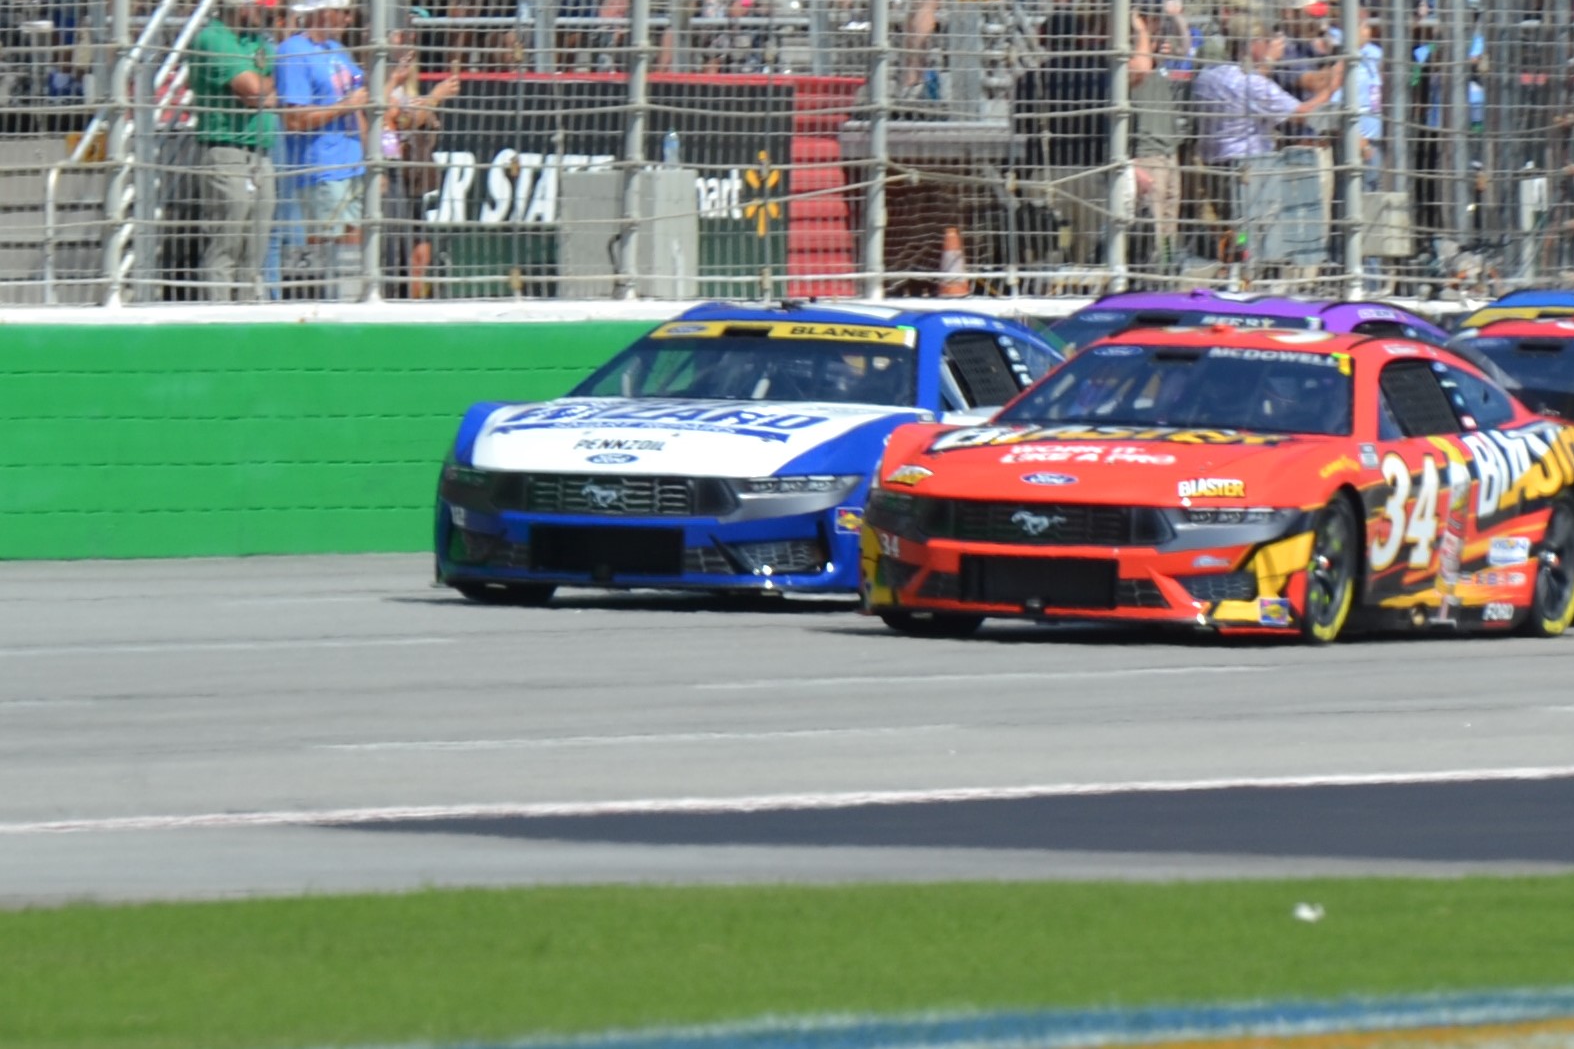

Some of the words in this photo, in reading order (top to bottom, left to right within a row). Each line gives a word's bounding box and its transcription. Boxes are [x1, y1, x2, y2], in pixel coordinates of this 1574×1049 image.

[1200, 314, 1276, 329] BERRY
[789, 325, 893, 341] BLANEY
[573, 438, 667, 452] PENNZOIL
[1178, 478, 1247, 498] BLASTER
[1368, 450, 1440, 571] 34
[880, 532, 900, 559] 34
